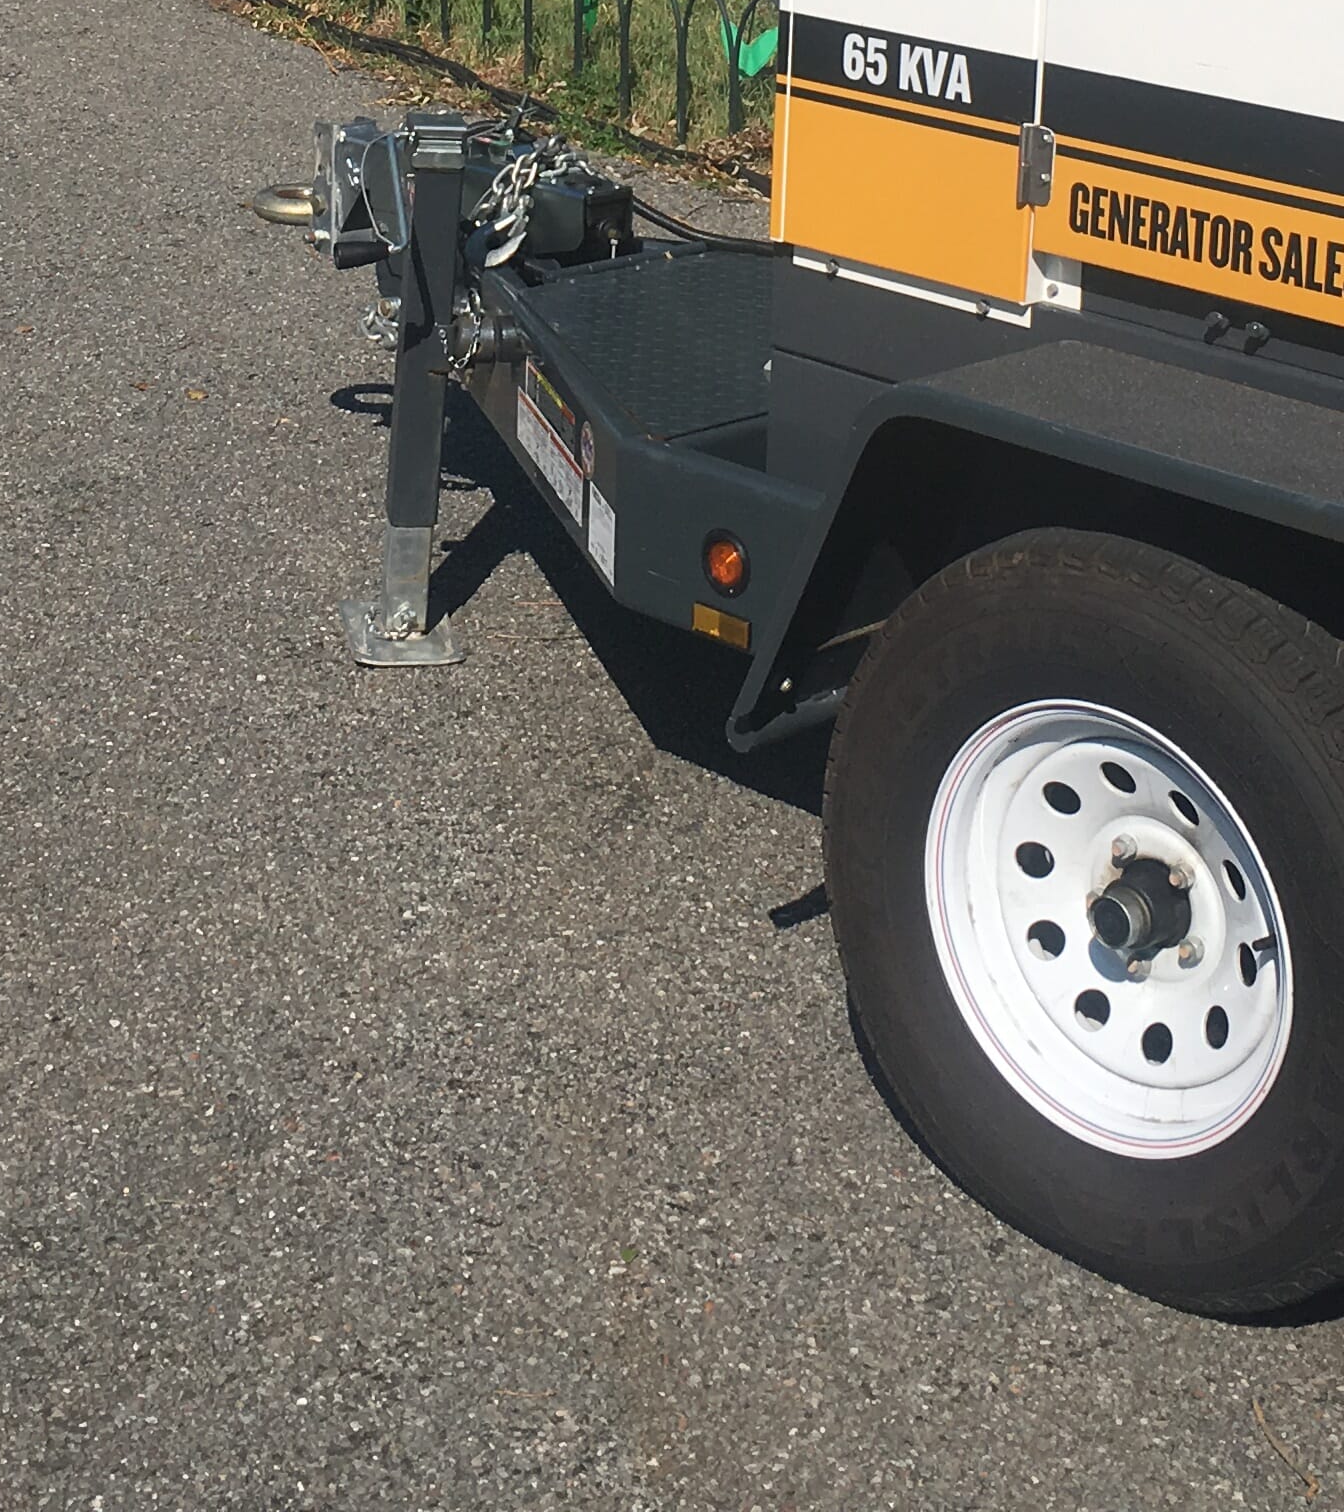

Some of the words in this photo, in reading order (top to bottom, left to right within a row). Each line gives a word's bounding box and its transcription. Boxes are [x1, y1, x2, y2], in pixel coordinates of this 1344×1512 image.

[843, 32, 888, 86] 65
[898, 42, 972, 104] KVA
[1069, 182, 1253, 276] GENERATOR
